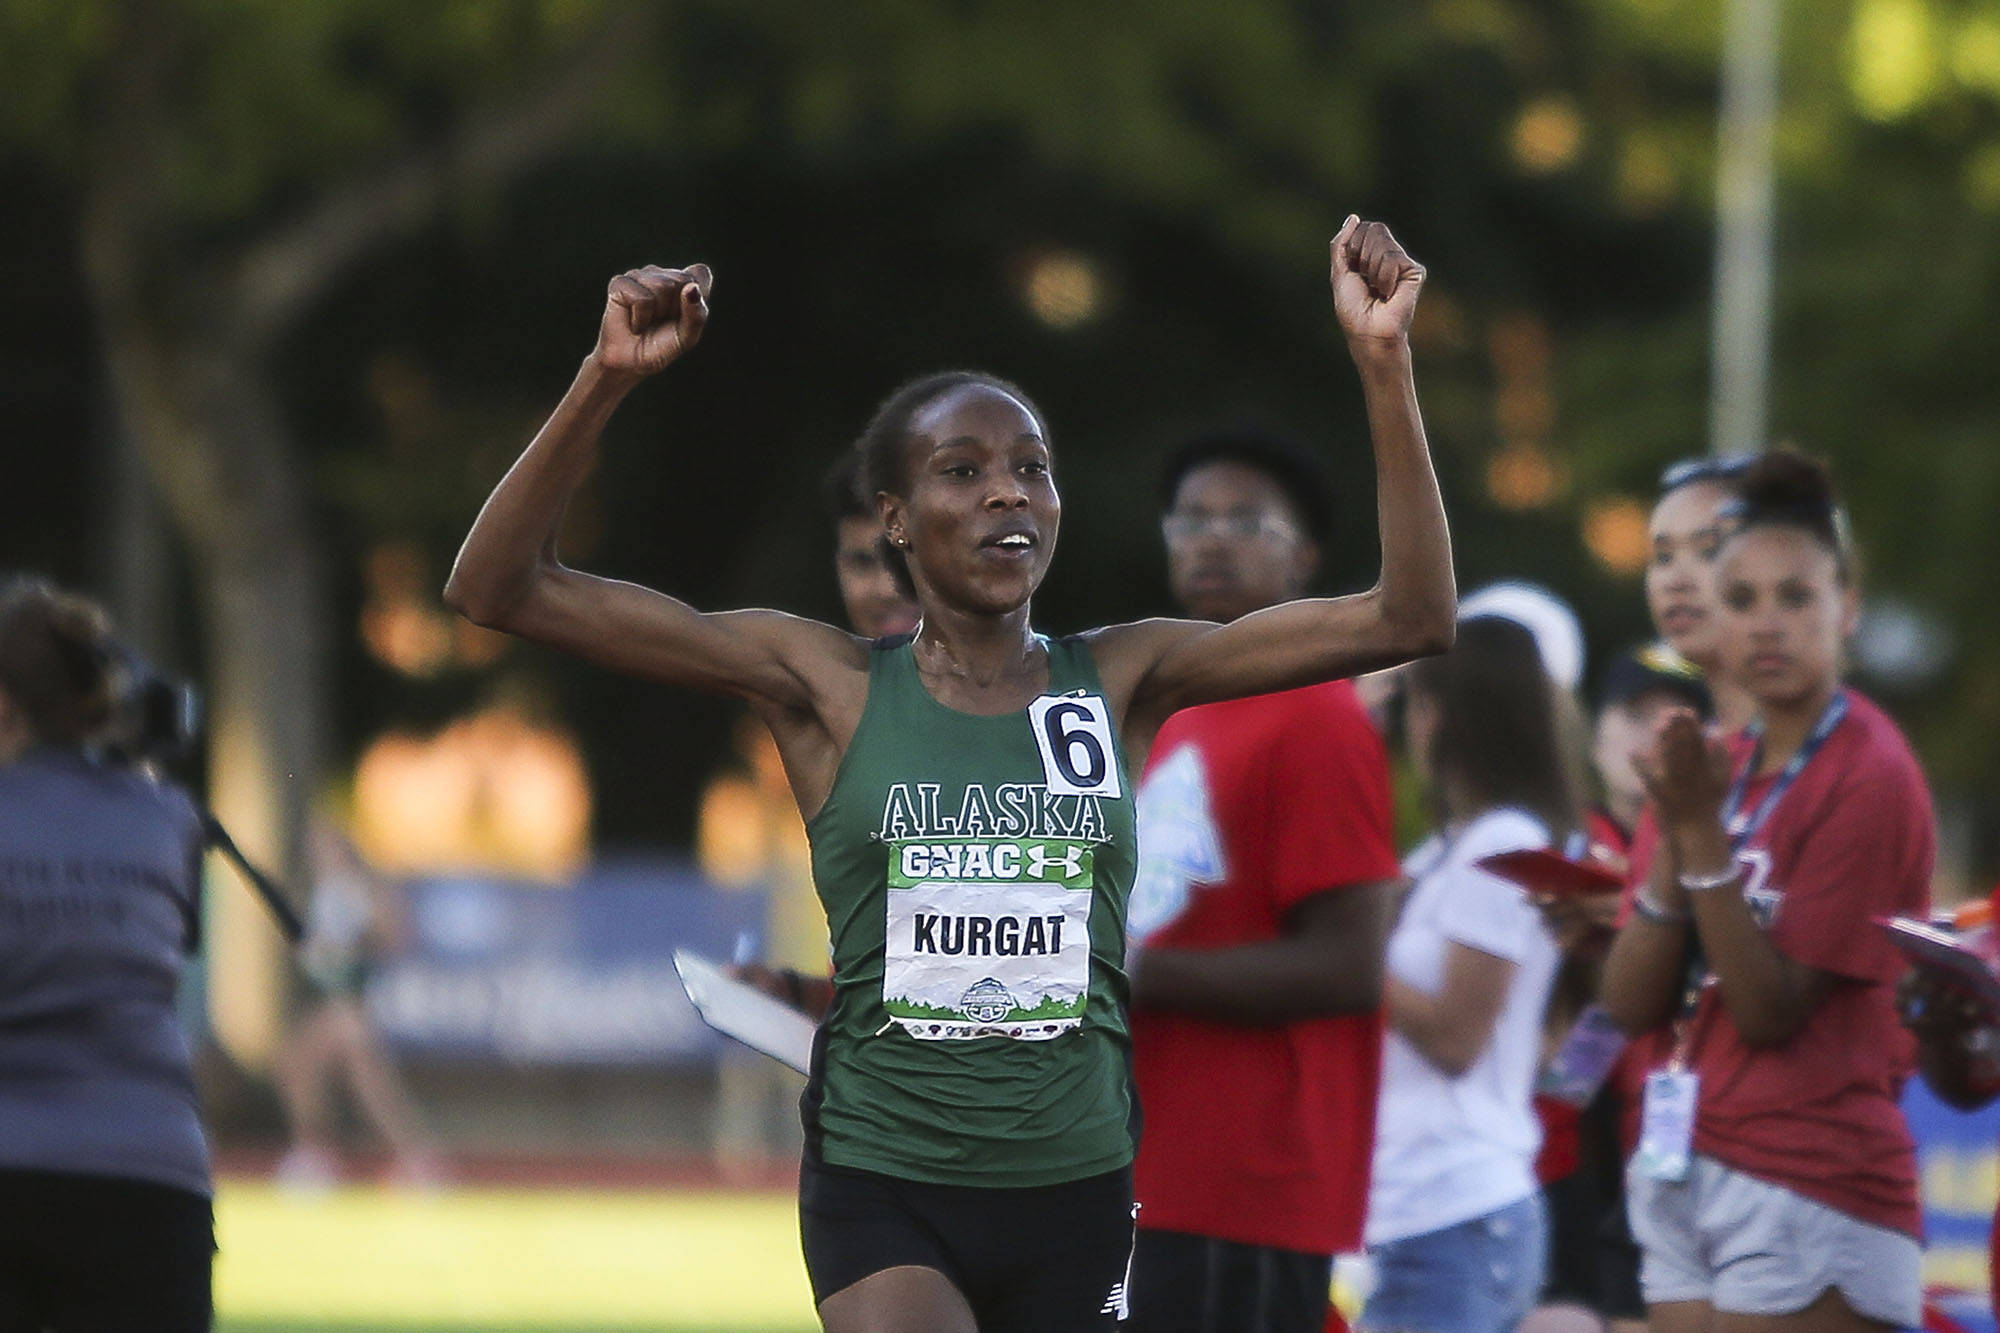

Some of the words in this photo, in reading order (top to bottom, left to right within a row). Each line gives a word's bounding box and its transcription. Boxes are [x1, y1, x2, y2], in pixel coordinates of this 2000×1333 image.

[1044, 702, 1105, 788] 6
[880, 783, 1105, 841] ALASKA
[902, 844, 1021, 879] GNAC
[914, 914, 1065, 956] KURGAT
